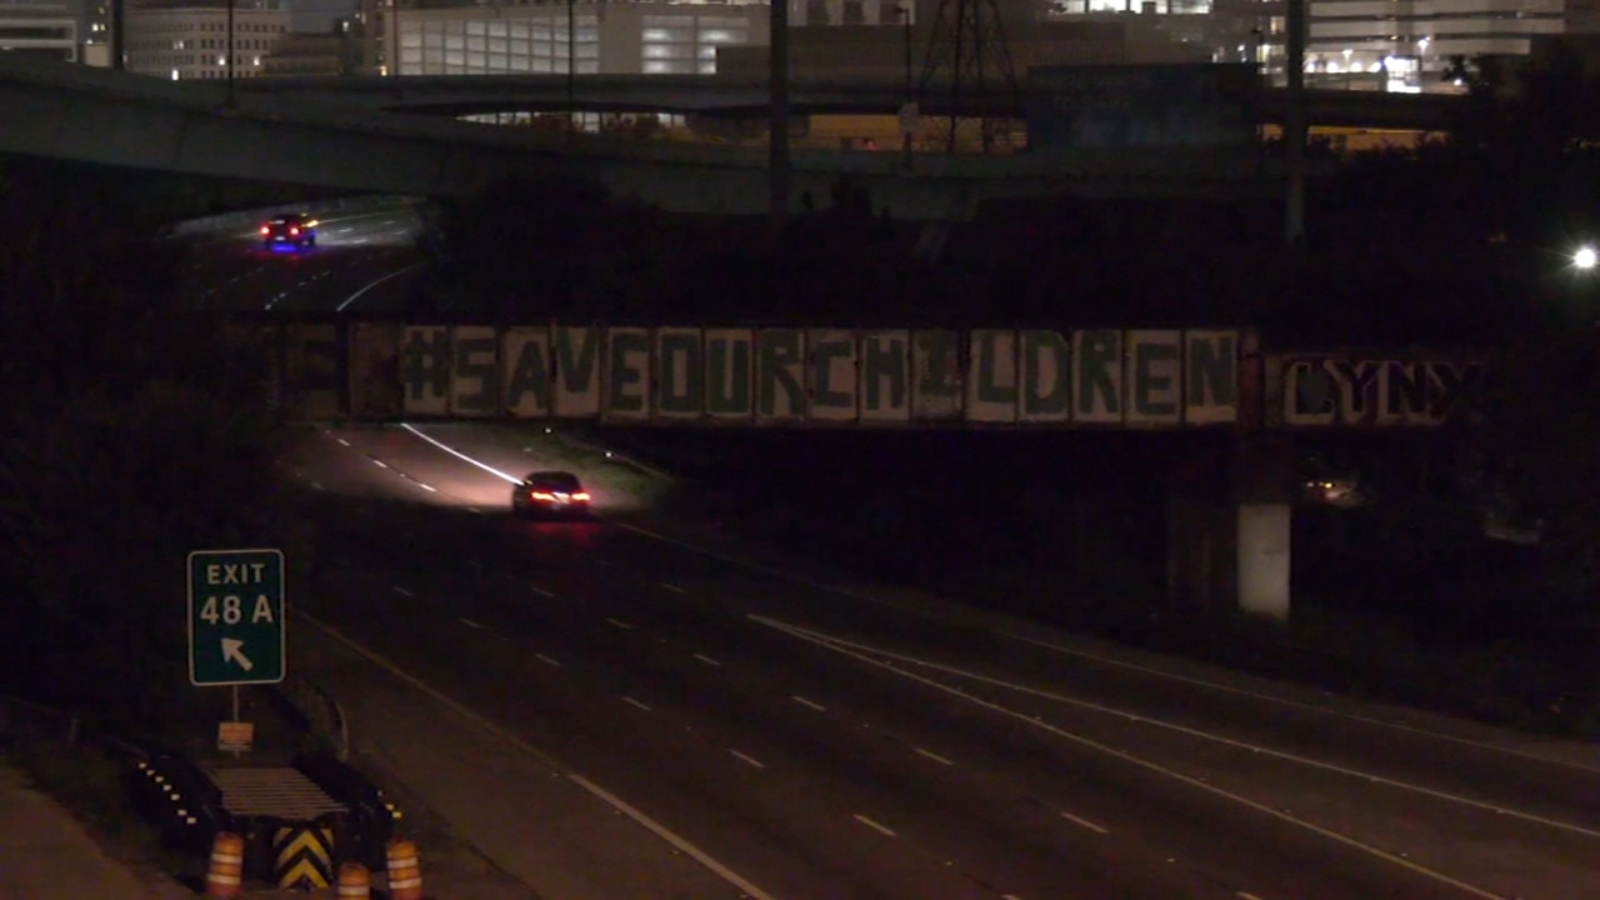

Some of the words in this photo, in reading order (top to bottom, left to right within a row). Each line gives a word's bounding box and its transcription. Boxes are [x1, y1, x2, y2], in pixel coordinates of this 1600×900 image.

[1284, 357, 1487, 425] LYNX
[206, 563, 265, 585] EXIT
[200, 594, 242, 625] 48
[251, 594, 274, 624] A
